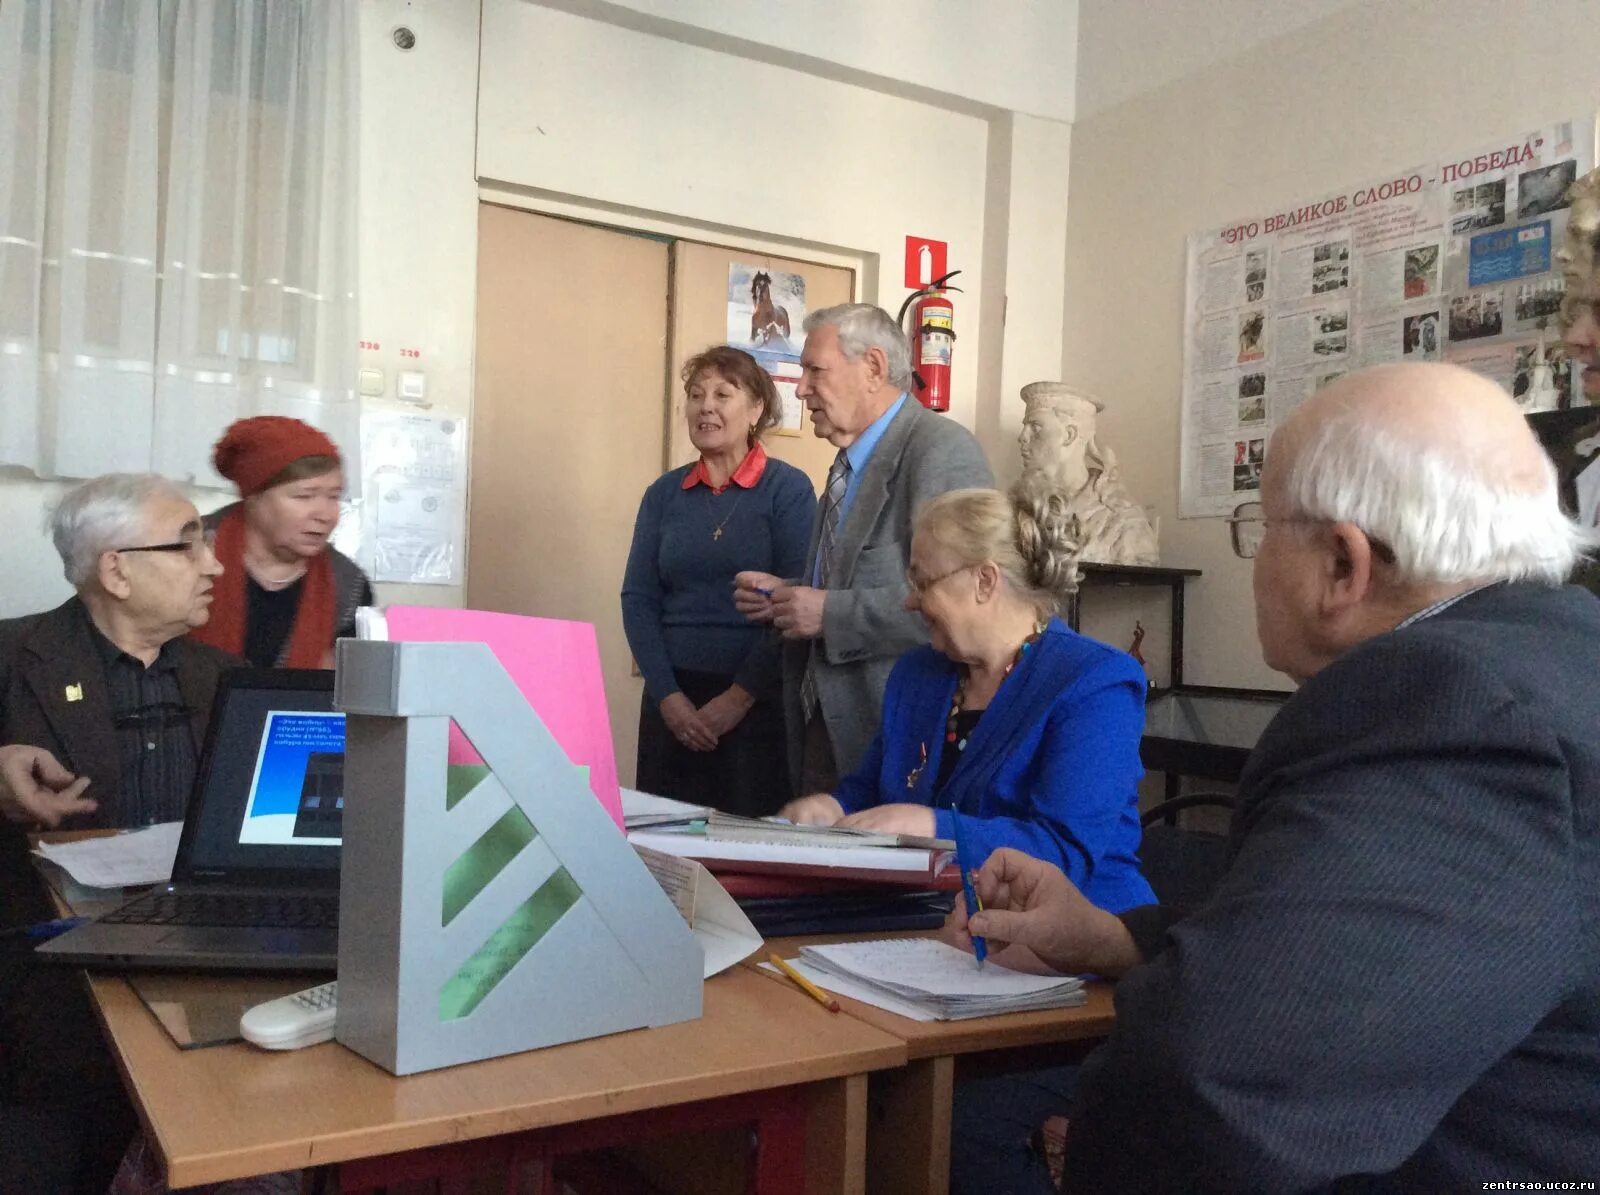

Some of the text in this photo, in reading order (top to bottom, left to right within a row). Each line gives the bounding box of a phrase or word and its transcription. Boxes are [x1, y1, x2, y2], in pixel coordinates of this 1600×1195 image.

[1263, 195, 1348, 234] ВЕЛИКОЕ
[1352, 174, 1422, 208] СЛОВО
[359, 341, 380, 351] 220
[399, 348, 420, 358] 220
